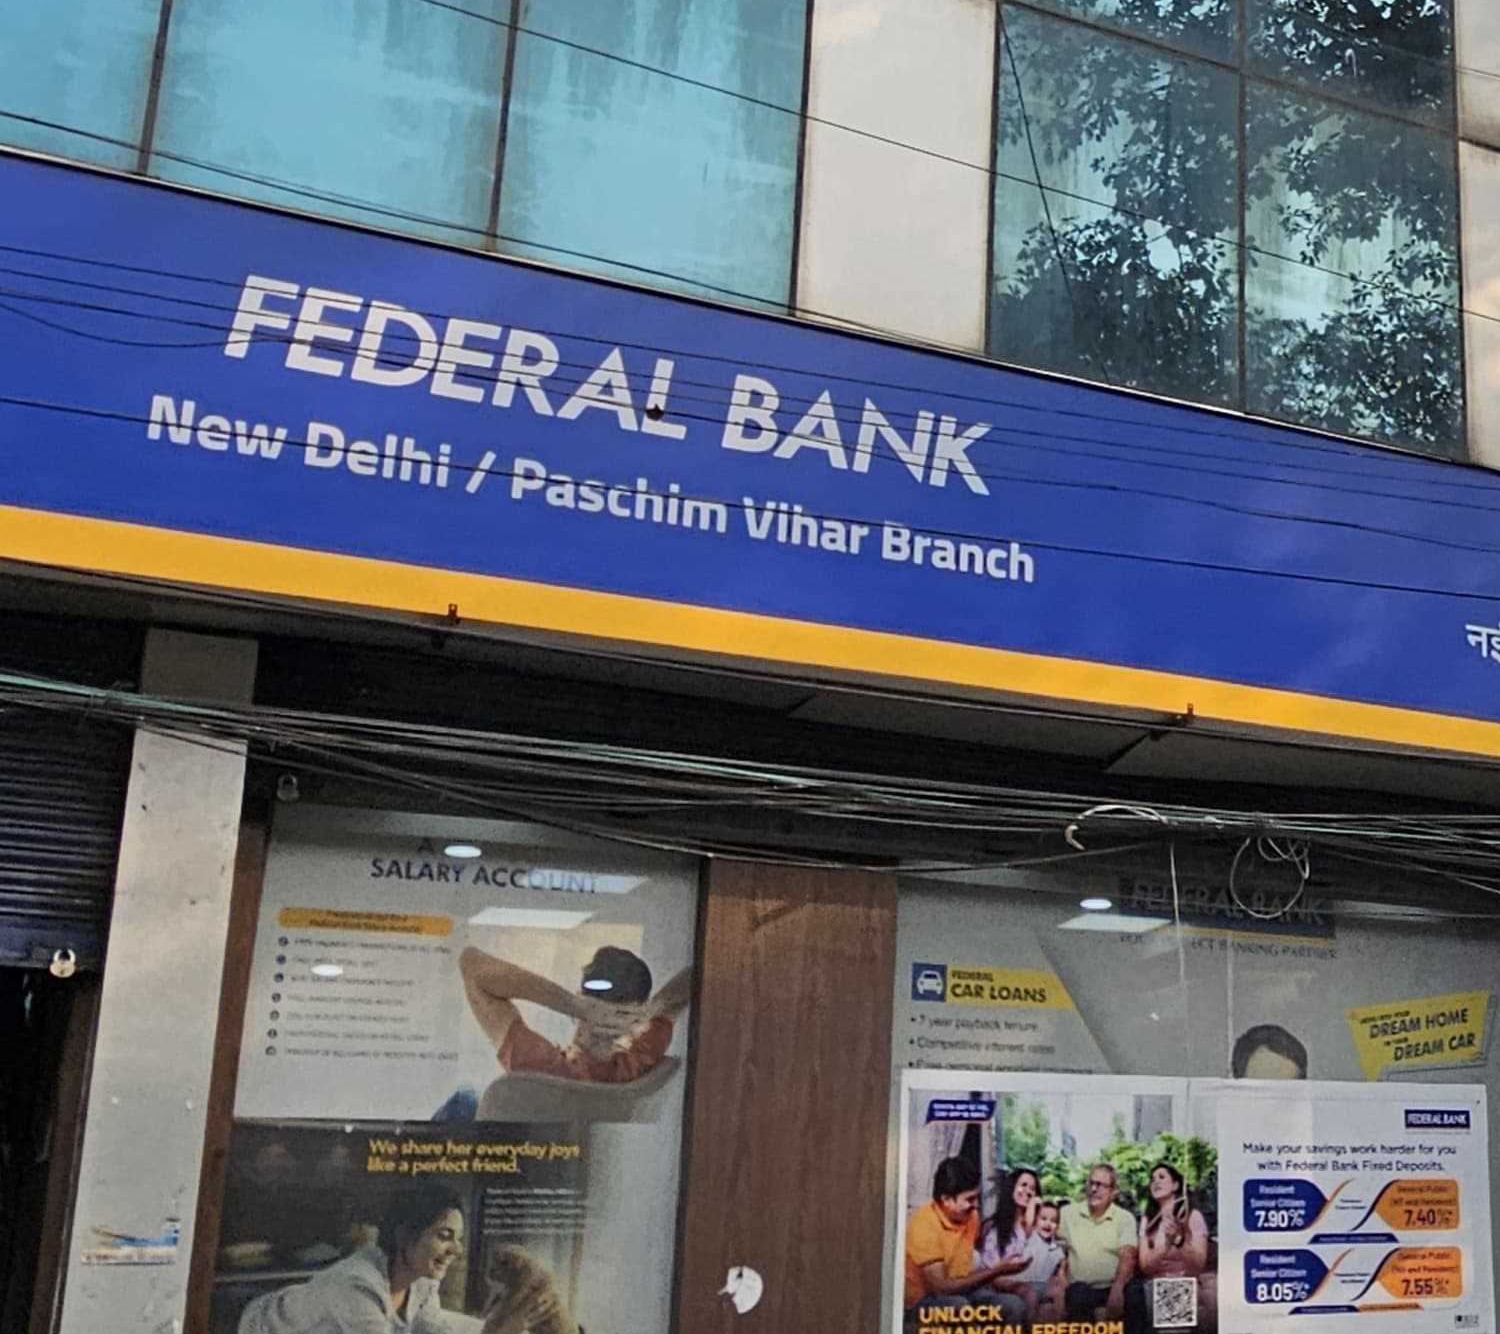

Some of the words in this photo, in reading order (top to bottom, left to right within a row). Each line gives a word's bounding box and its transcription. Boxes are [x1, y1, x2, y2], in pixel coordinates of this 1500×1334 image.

[224, 274, 688, 441] FEDERAL
[721, 374, 993, 496] BANK
[147, 394, 288, 460] New
[304, 422, 452, 488] Delhi
[465, 450, 497, 494] /
[510, 457, 729, 534] Paschim
[743, 496, 870, 555] Vihar
[881, 521, 1034, 583] Branch
[371, 858, 463, 884] SALARY
[950, 983, 985, 1000] CAR
[990, 985, 1048, 1004] LOANS
[1369, 1016, 1421, 1040] DREAM
[1425, 1008, 1469, 1030] HOME
[1393, 1038, 1445, 1062] DREAM
[1447, 1032, 1476, 1051] CAR
[1406, 1113, 1443, 1126] FEDERAL
[1443, 1113, 1468, 1126] BANK
[369, 1139, 397, 1155] We
[401, 1140, 443, 1155] share
[446, 1140, 472, 1155] her
[475, 1142, 548, 1159] everyday
[1243, 1143, 1273, 1155] Make
[1277, 1144, 1302, 1156] your
[1306, 1143, 1347, 1157] savings
[1350, 1143, 1377, 1155] work
[1380, 1143, 1415, 1155] harder
[1418, 1143, 1434, 1155] for
[1437, 1145, 1457, 1157] you
[367, 1157, 396, 1173] like
[399, 1160, 409, 1172] a
[412, 1157, 469, 1177] perfect
[1257, 1160, 1282, 1171] with
[1285, 1160, 1328, 1171] Federal
[1332, 1160, 1359, 1171] Bank
[918, 1304, 1003, 1324] UNLOCK
